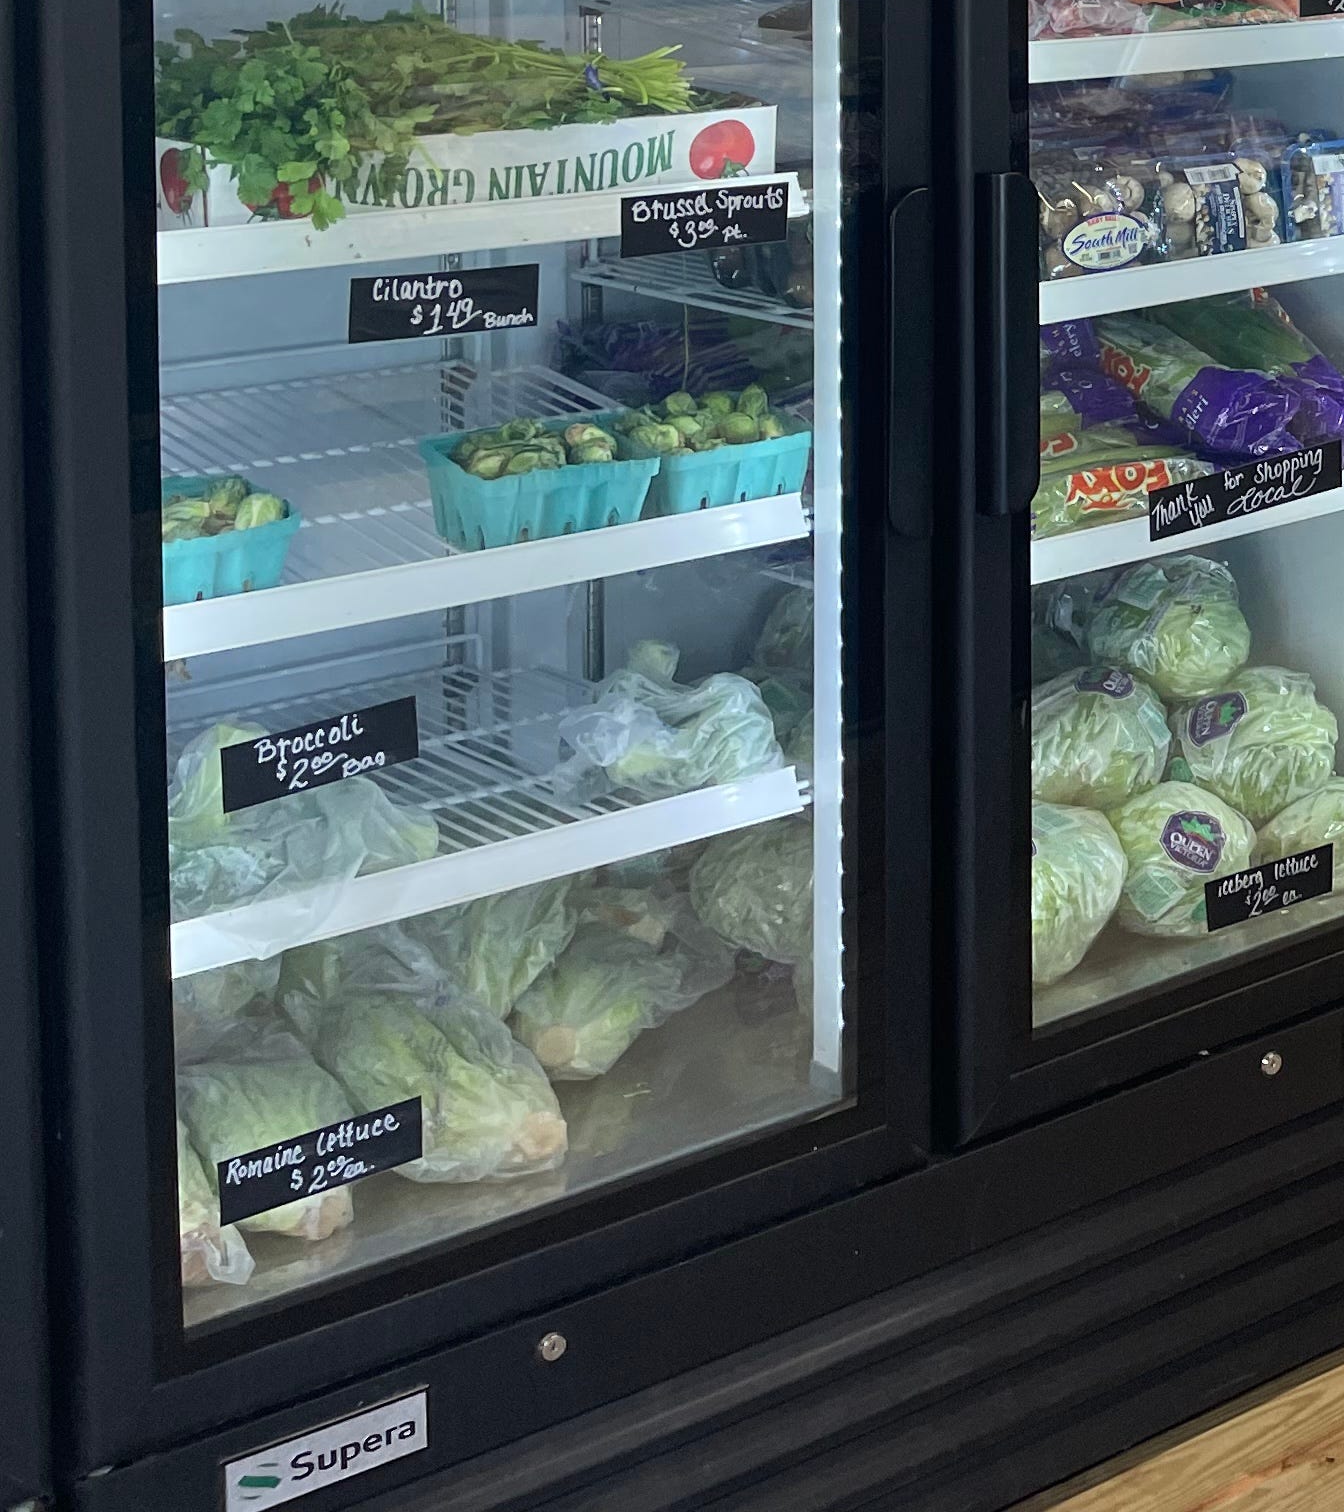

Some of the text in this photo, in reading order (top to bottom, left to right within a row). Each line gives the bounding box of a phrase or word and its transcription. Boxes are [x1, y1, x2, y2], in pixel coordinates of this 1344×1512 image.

[488, 129, 677, 202] MOUNTAIN
[716, 185, 785, 212] Sprouts
[1070, 227, 1138, 256] South Mill
[371, 276, 464, 303] Cilantro
[1223, 469, 1246, 490] for
[1150, 483, 1200, 531] Thank
[1188, 493, 1215, 528] you
[253, 713, 365, 764] Broccoli
[1169, 831, 1214, 861] QUEEN
[225, 1144, 308, 1185] Romaine
[290, 1420, 416, 1481] Supera
